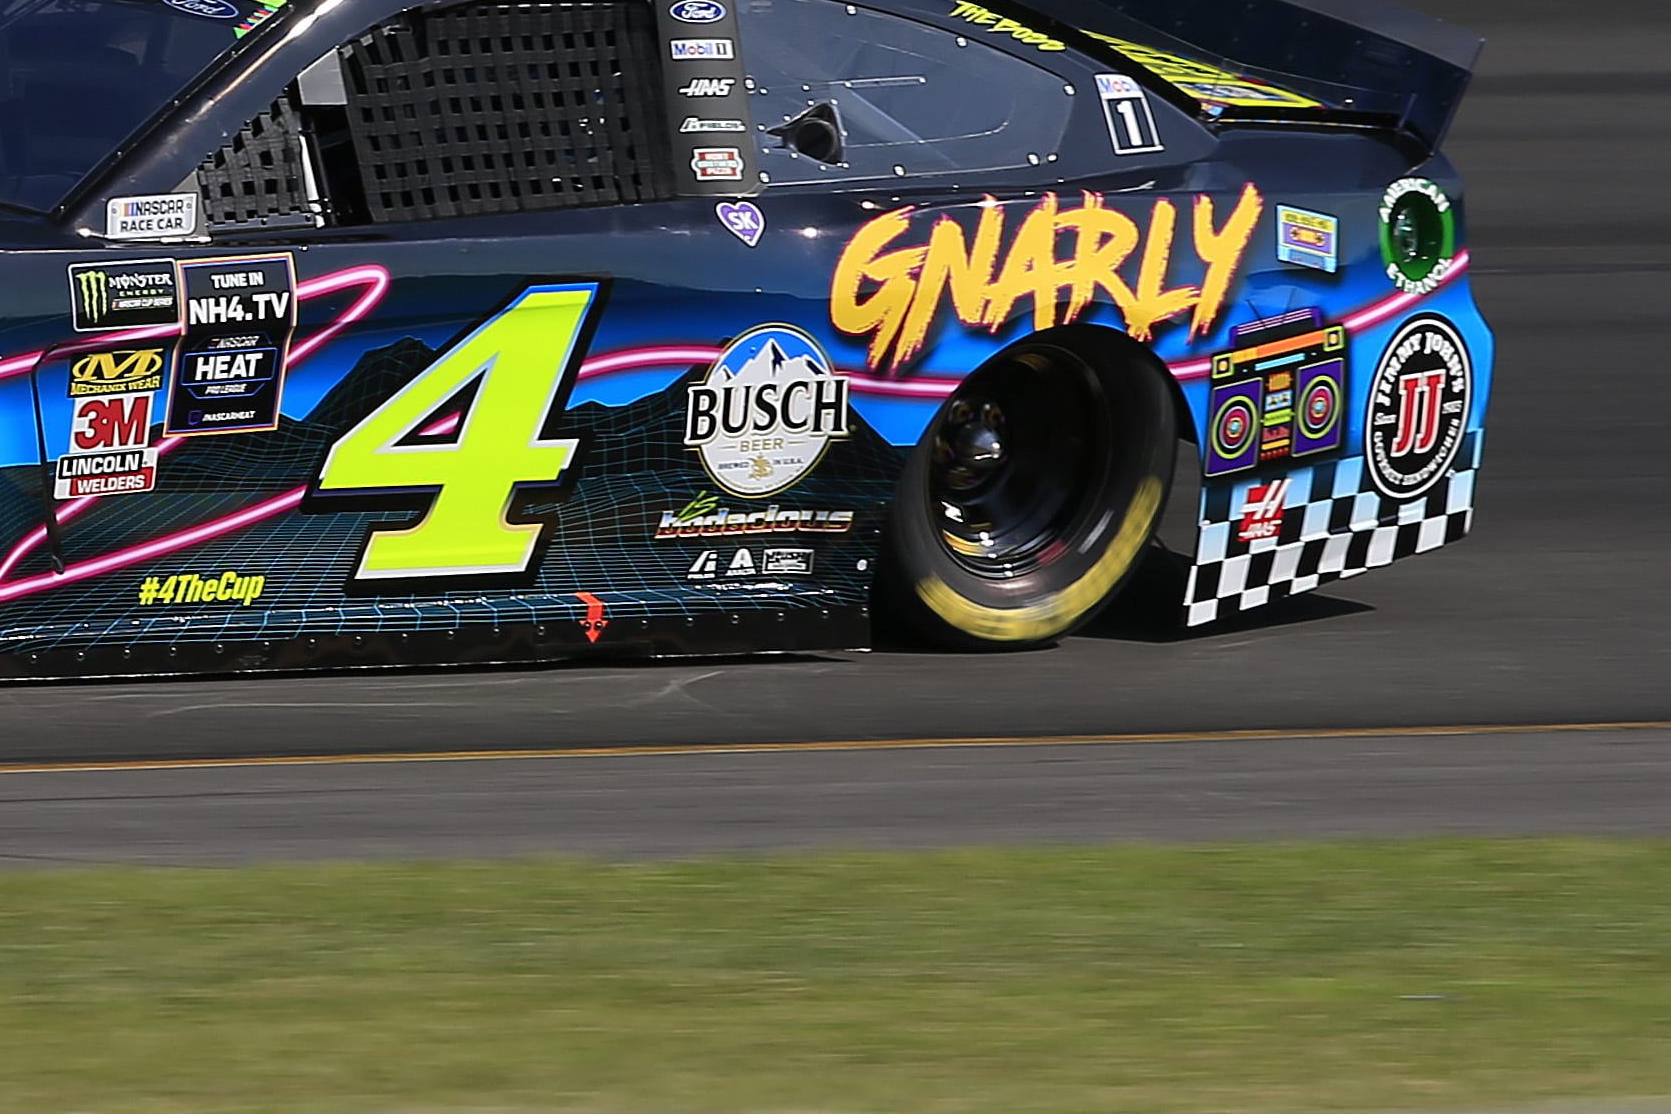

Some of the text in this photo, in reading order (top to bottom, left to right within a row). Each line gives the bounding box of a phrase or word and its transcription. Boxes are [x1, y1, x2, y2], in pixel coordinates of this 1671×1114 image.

[681, 2, 717, 19] Ford
[948, 0, 1003, 25] THE
[673, 42, 727, 56] Mobil 1
[1116, 100, 1143, 147] 1
[136, 199, 184, 217] NASCAR
[1378, 177, 1451, 223] AMERICAN
[120, 217, 184, 233] RACE CAR
[728, 211, 759, 231] SK
[108, 273, 174, 289] MONSTER
[211, 272, 265, 288] TUNE IN
[831, 182, 1264, 374] GNARLY
[1386, 258, 1453, 295] ETHANOL
[119, 288, 165, 297] ENERGY
[189, 292, 290, 324] NH4.TV
[195, 352, 264, 380] HEAT
[1375, 333, 1422, 406] JIMMY
[1423, 331, 1464, 393] JOHN'S
[71, 375, 161, 396] MECHANIX WEAR
[74, 396, 150, 449] 3M
[684, 376, 850, 446] BUSCH
[1390, 368, 1447, 457] JJ
[314, 281, 600, 580] 4
[739, 438, 784, 453] BEER
[62, 453, 140, 477] LINCOLN
[77, 474, 146, 494] WELDERS
[654, 504, 854, 540] bodacious
[138, 571, 265, 606] #4TheCup
